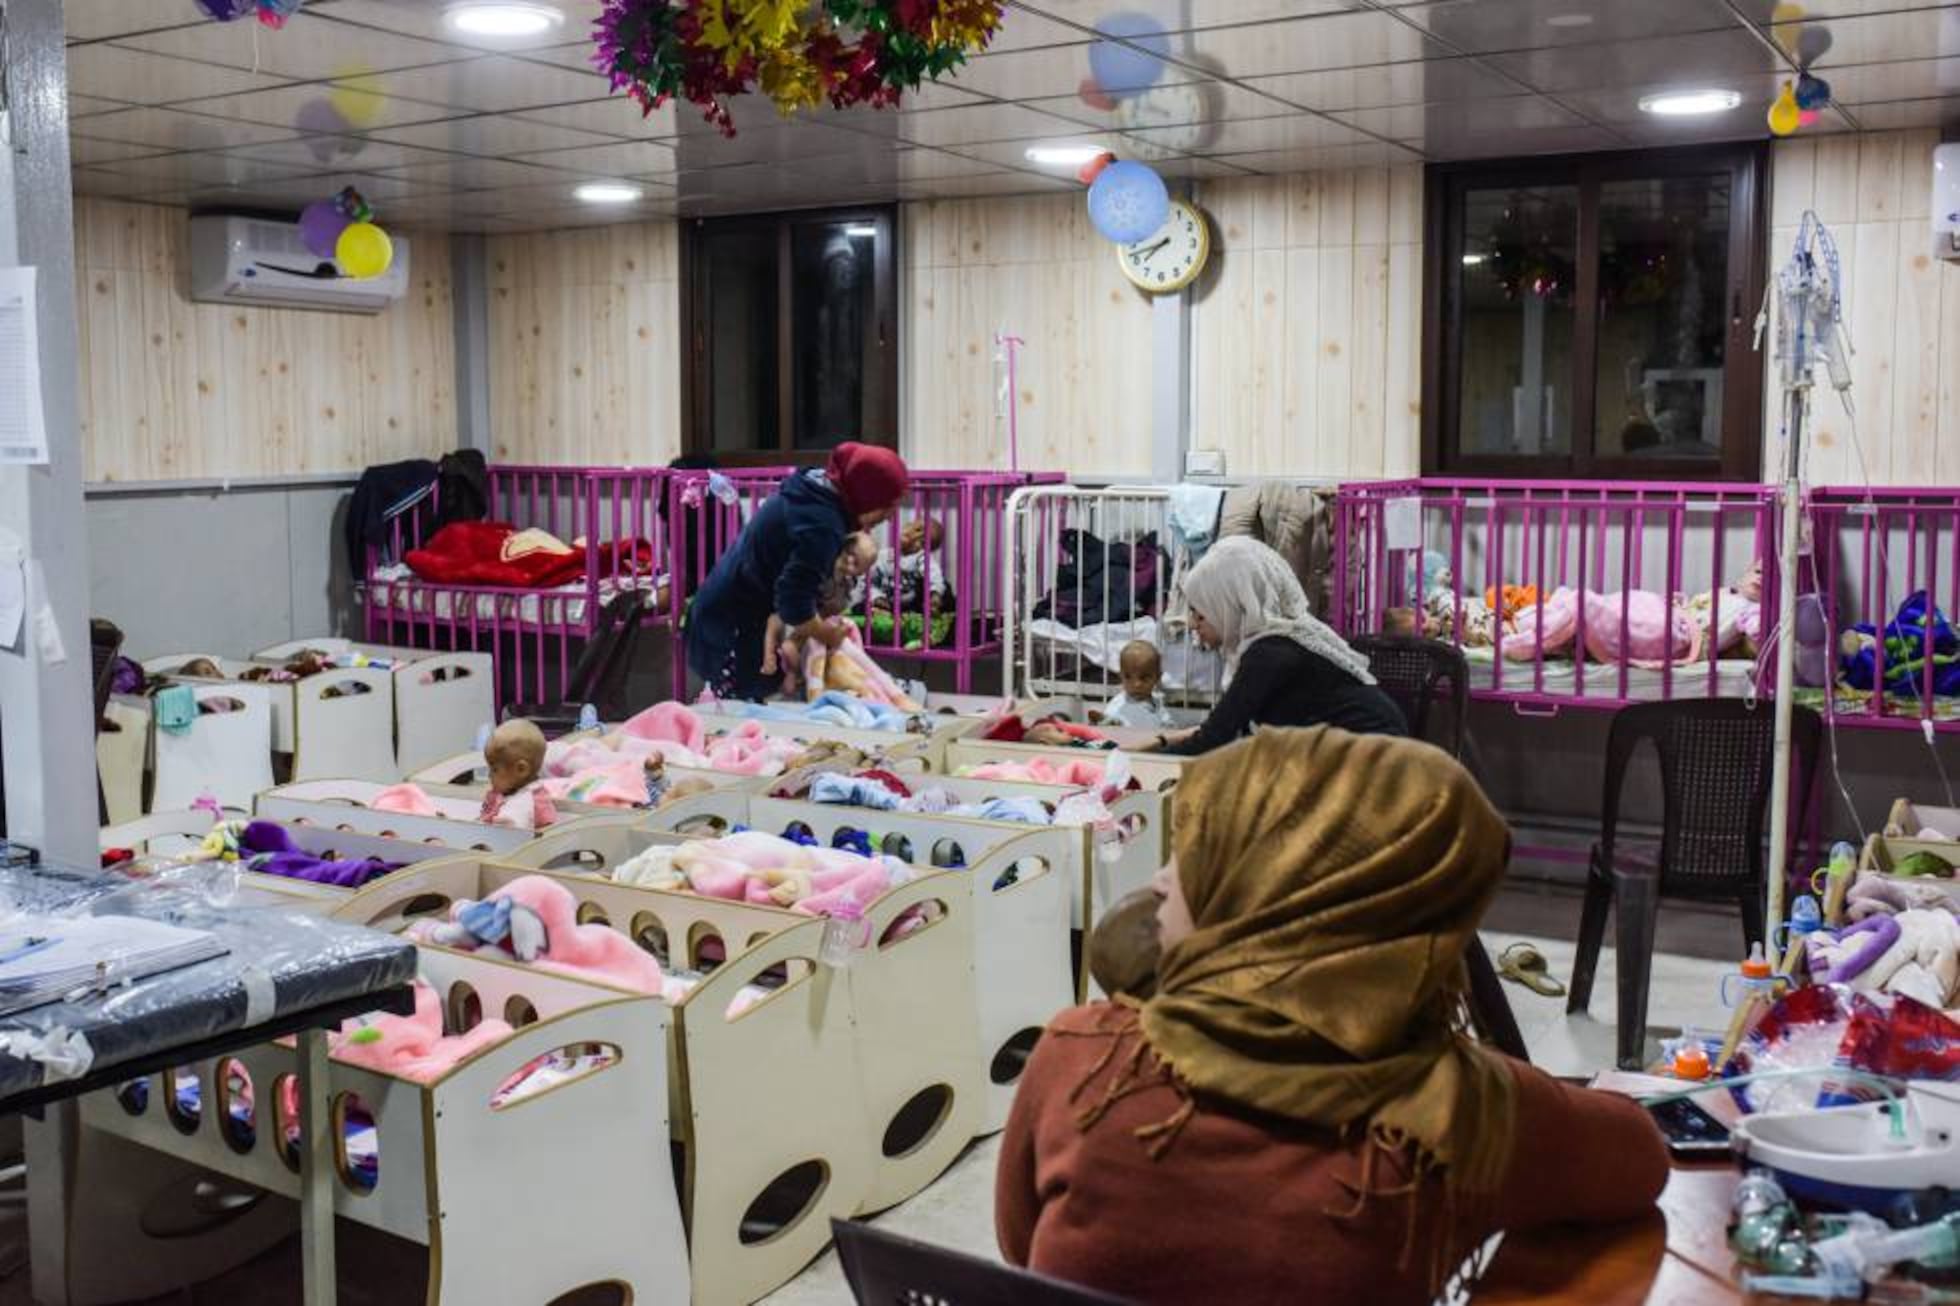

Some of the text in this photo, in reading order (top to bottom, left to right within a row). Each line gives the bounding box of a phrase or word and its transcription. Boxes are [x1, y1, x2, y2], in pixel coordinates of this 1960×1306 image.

[1187, 221, 1193, 232] 2
[1190, 238, 1197, 248] 3
[1144, 267, 1150, 277] 7
[1158, 271, 1165, 282] 6
